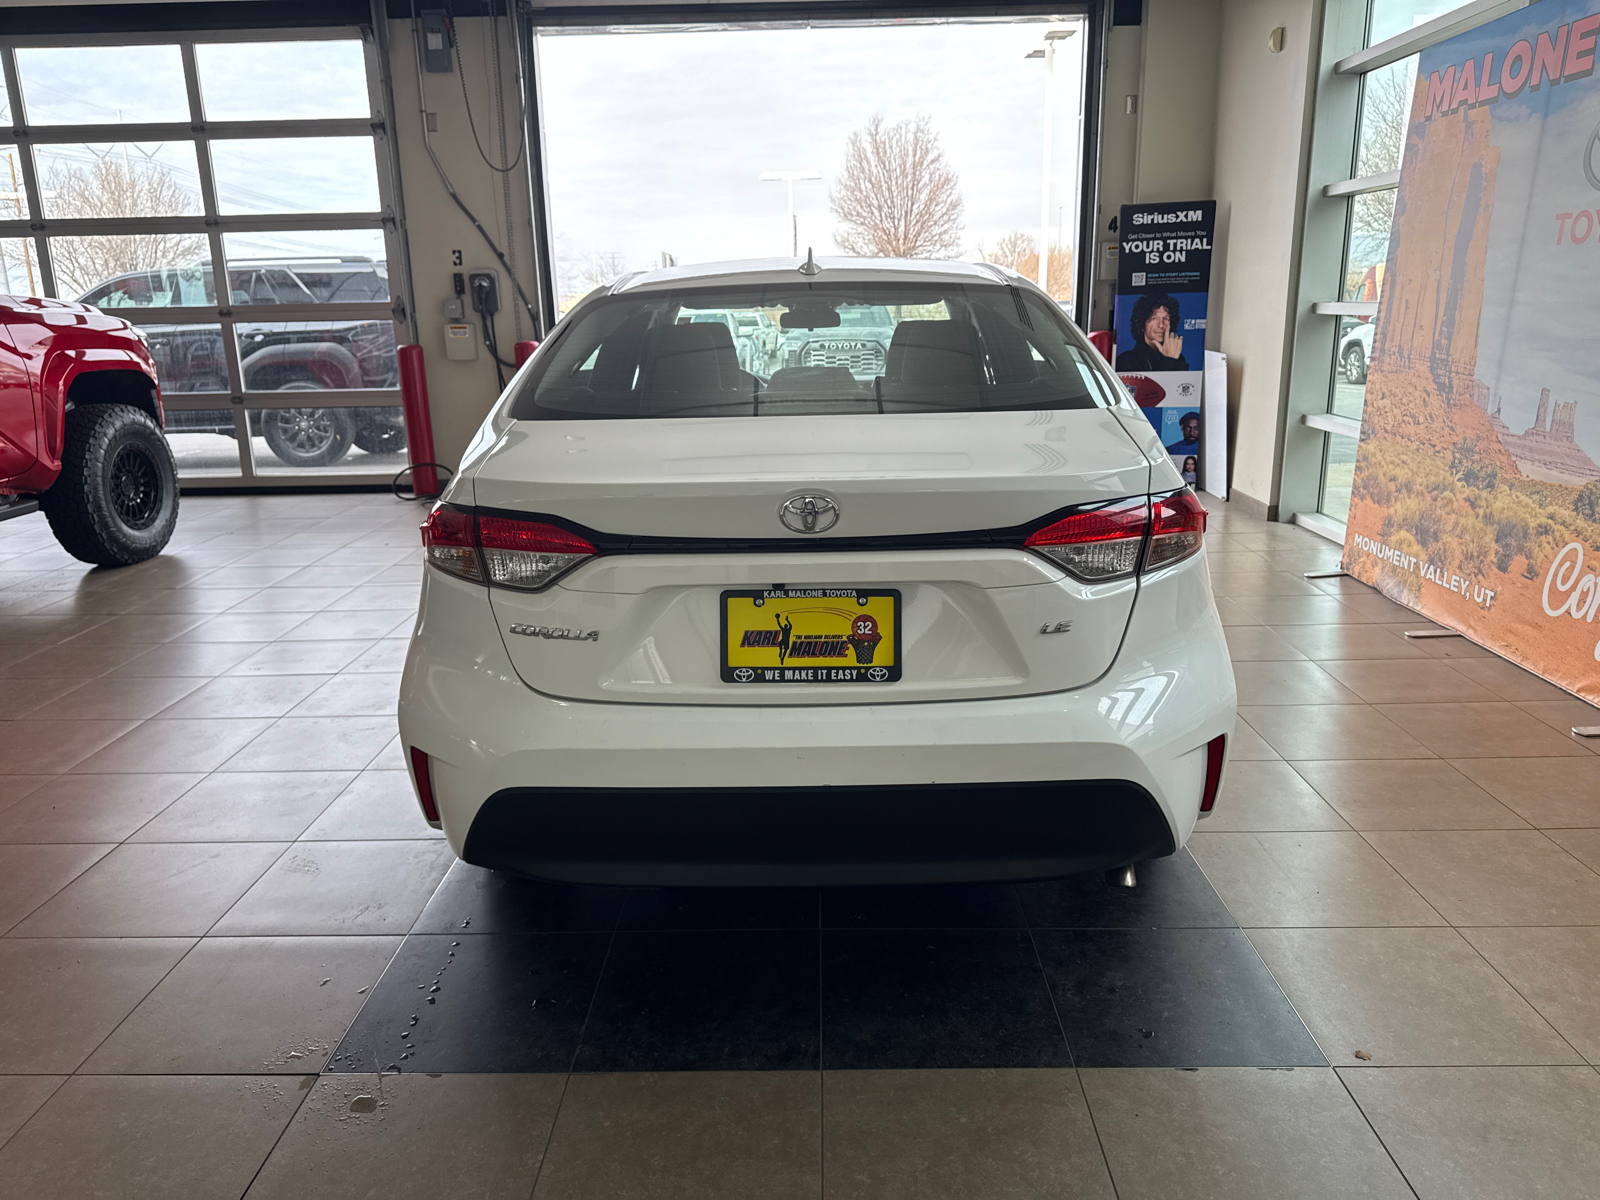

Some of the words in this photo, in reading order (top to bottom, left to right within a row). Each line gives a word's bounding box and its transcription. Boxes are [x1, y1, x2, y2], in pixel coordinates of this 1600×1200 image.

[1424, 11, 1600, 122] MALONE
[1108, 215, 1119, 234] 4
[1132, 210, 1203, 225] SiriusXM
[1555, 208, 1600, 246] TO
[1122, 240, 1164, 253] YOUR
[1167, 238, 1212, 251] TRIAL
[452, 249, 463, 266] 3
[1145, 252, 1160, 264] IS
[1163, 251, 1186, 263] ON
[824, 342, 863, 350] TOYOTA
[1353, 533, 1417, 572] MONUMENT
[1419, 560, 1470, 601] VALLEY,
[1473, 584, 1495, 607] UT
[763, 590, 787, 598] KARL
[788, 589, 823, 598] MALONE
[825, 589, 858, 598] TOYOTA
[509, 623, 600, 642] COROLLA
[857, 621, 873, 634] 32
[1040, 620, 1073, 634] LE
[740, 630, 781, 648] KARL
[788, 640, 850, 658] MALONE
[764, 670, 781, 680] WE
[784, 670, 814, 680] MAKE
[818, 669, 827, 680] IT
[831, 669, 858, 680] EASY
